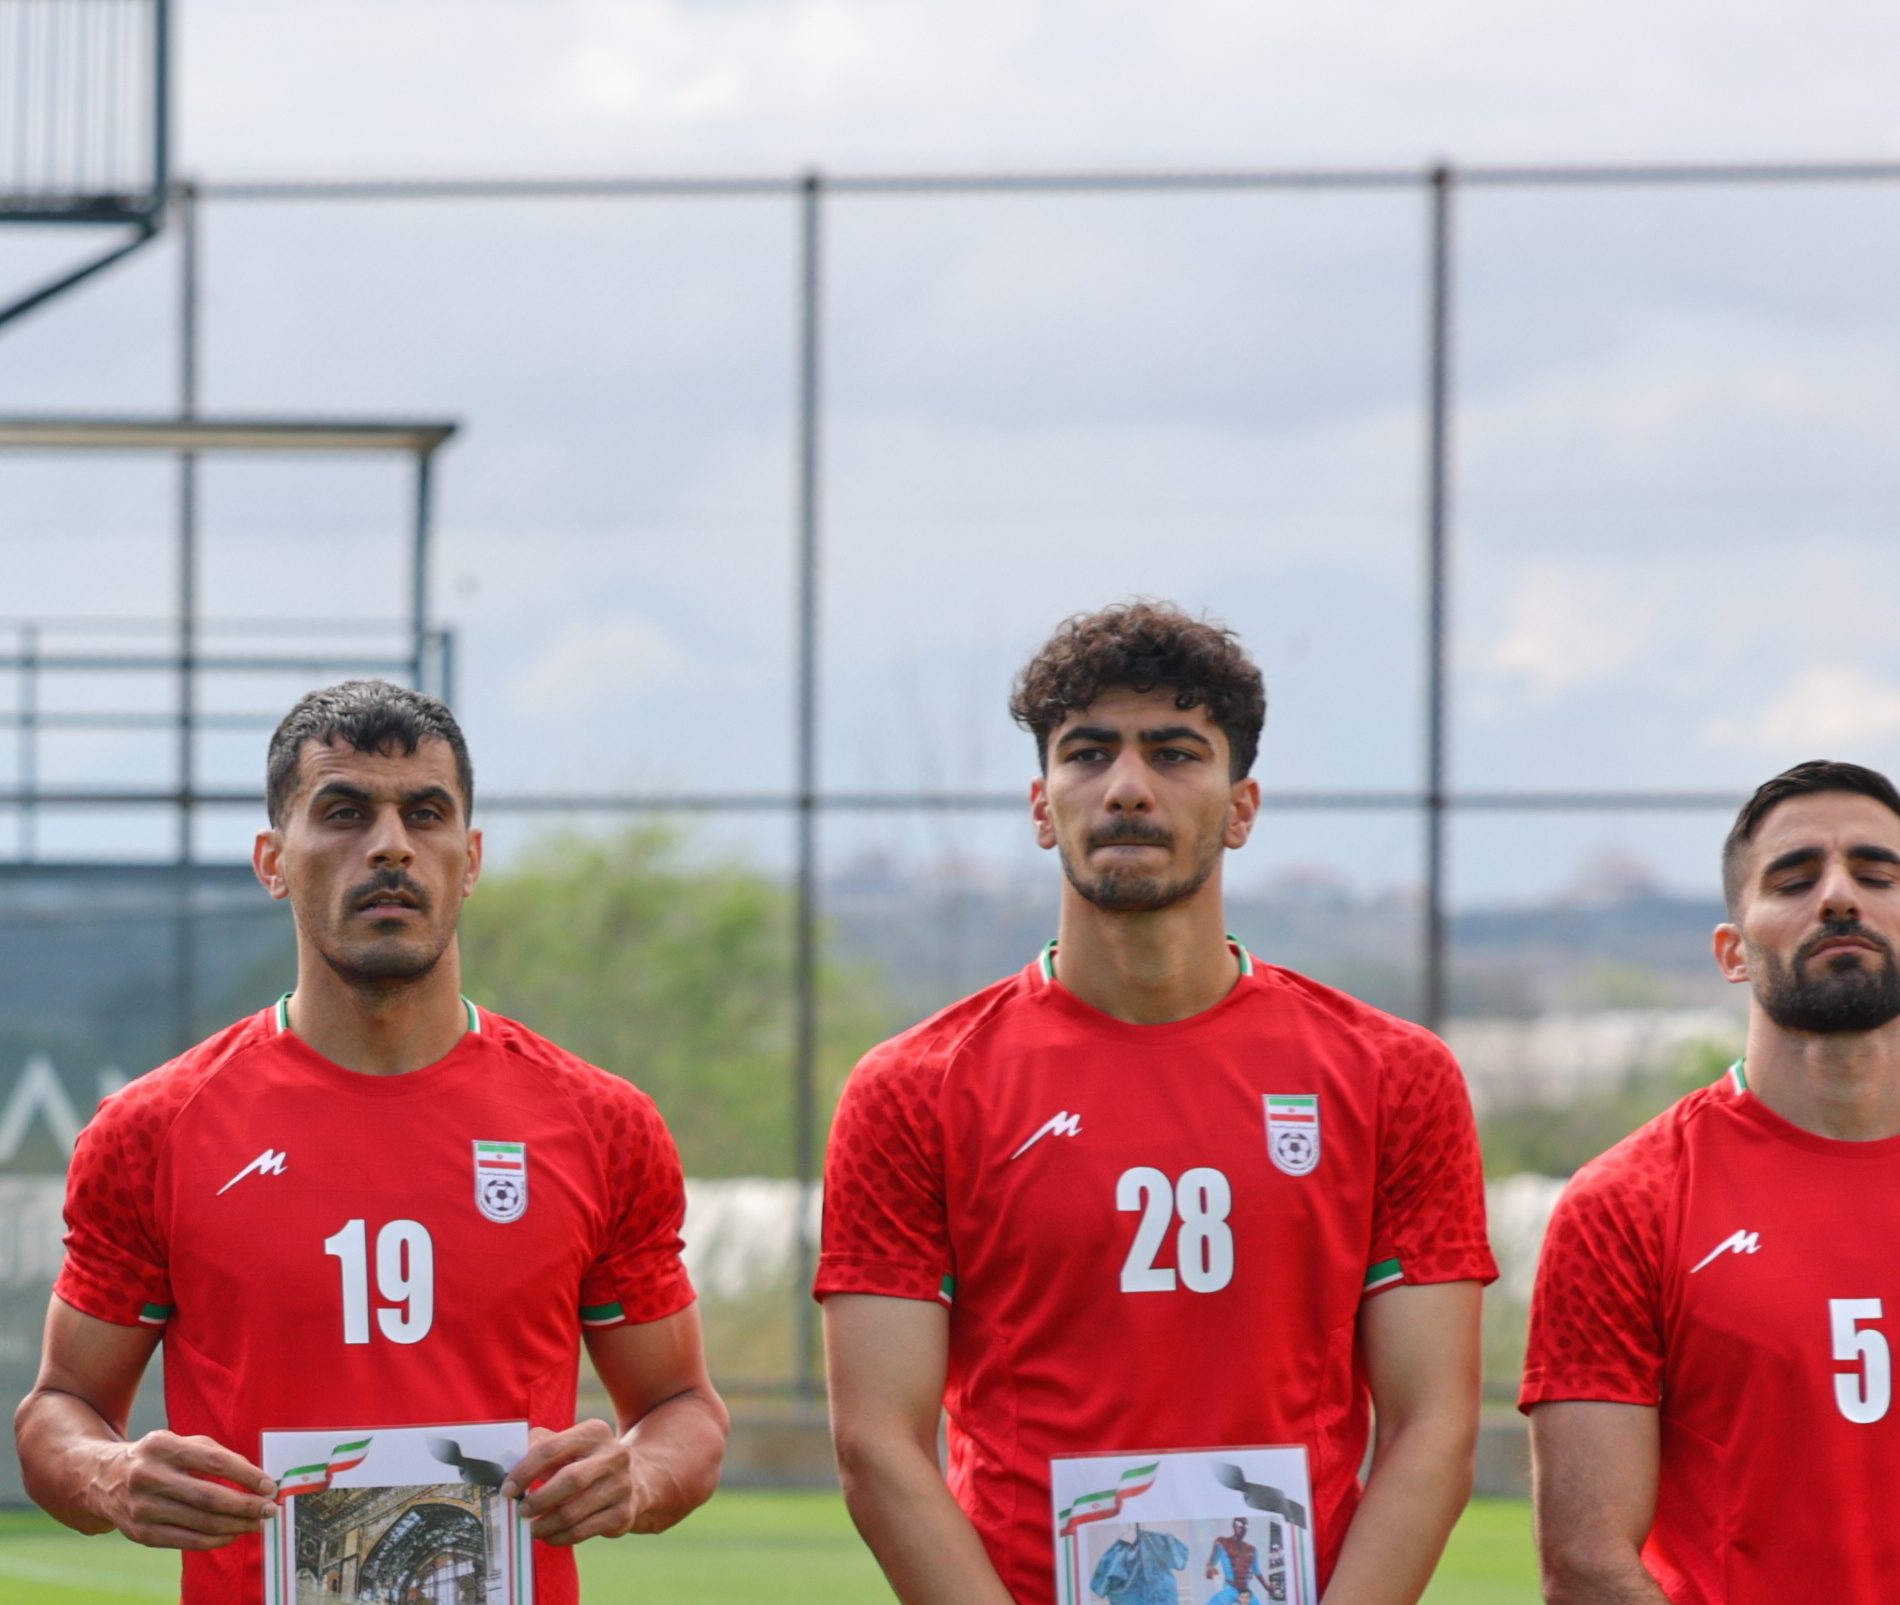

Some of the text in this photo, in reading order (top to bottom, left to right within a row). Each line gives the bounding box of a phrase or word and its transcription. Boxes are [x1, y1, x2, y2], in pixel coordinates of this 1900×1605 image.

[324, 1218, 435, 1345] 19
[1115, 1166, 1235, 1294] 28
[1829, 1298, 1893, 1425] 5
